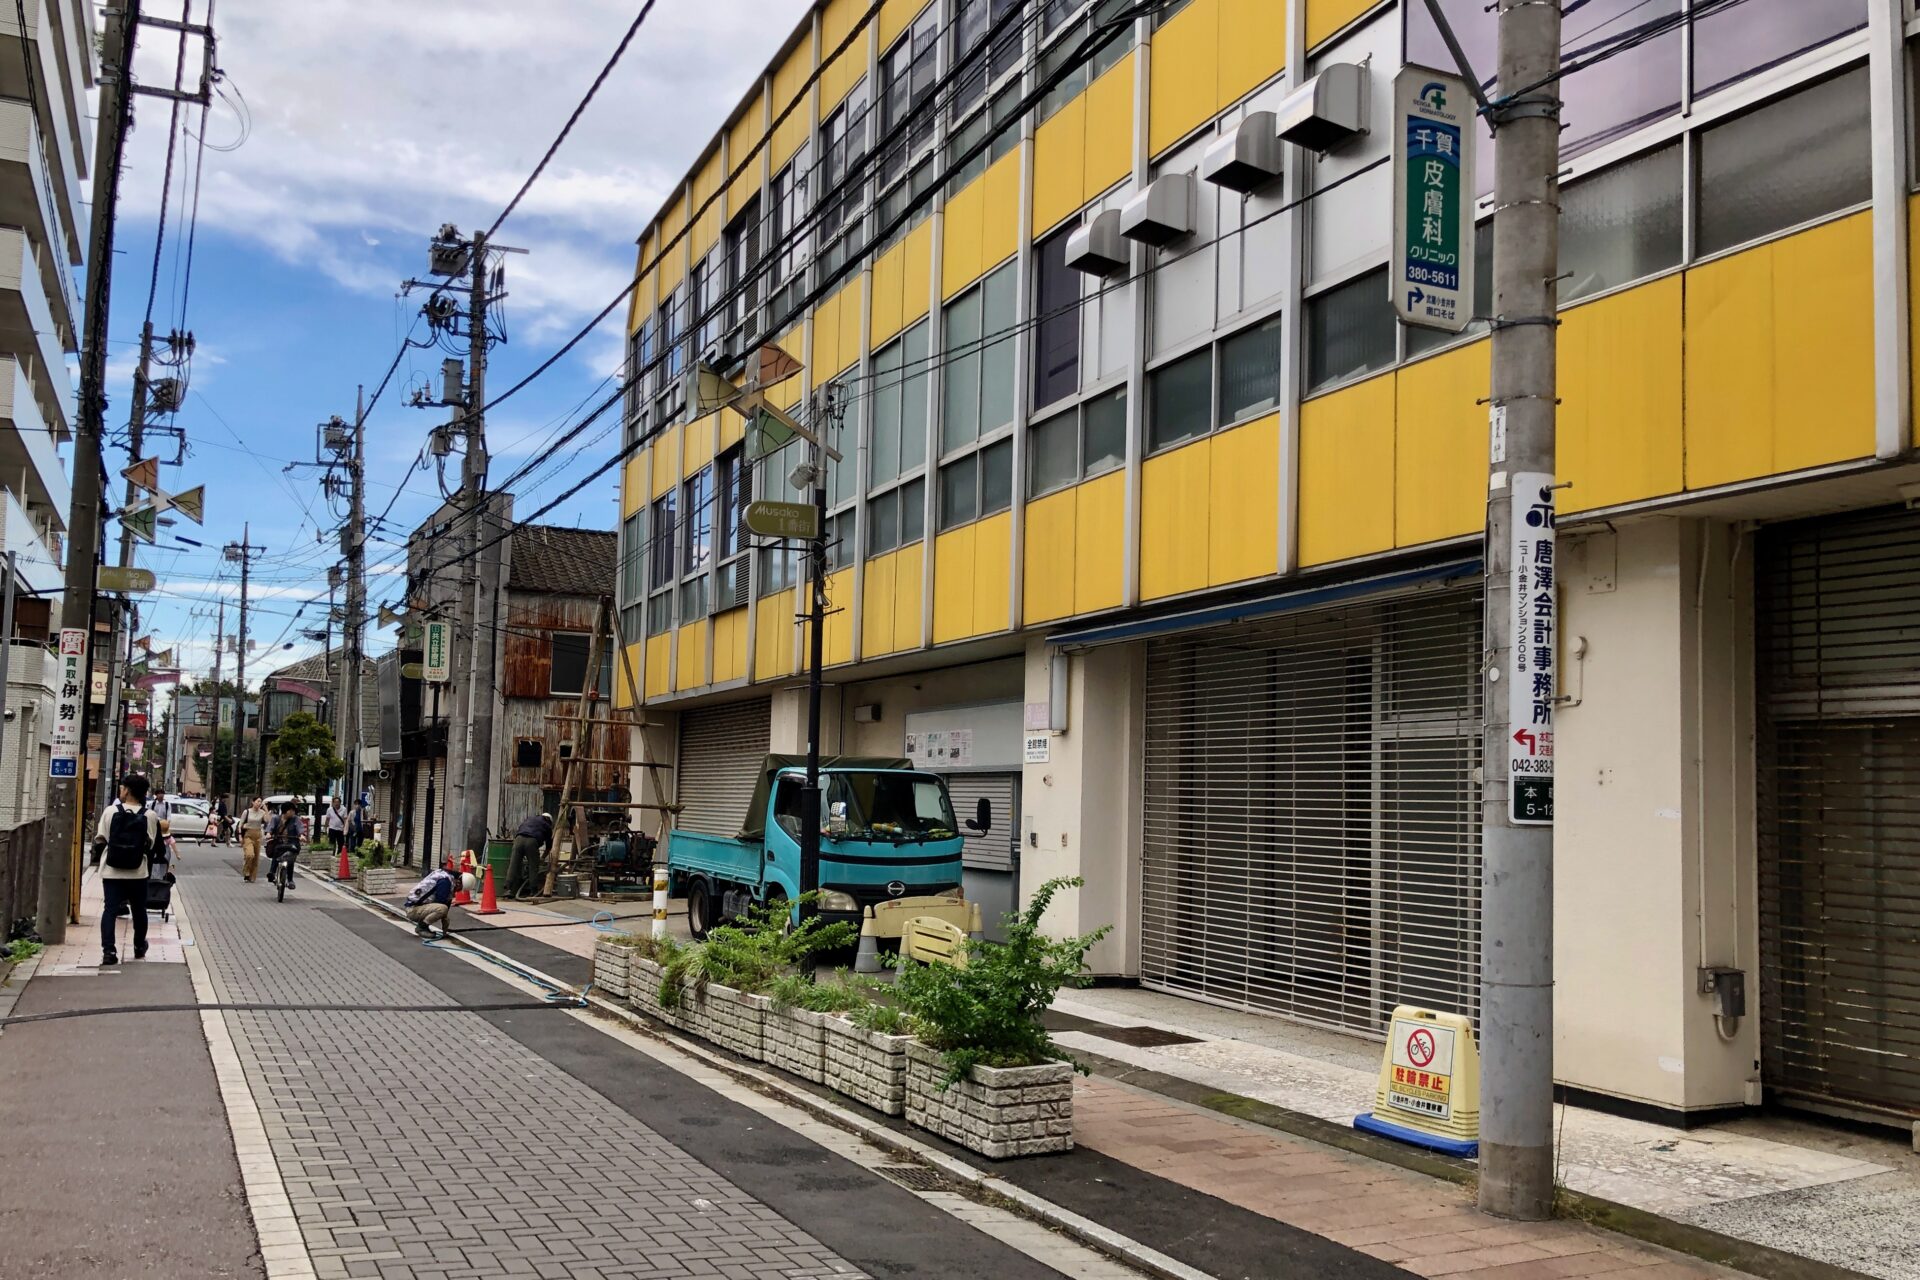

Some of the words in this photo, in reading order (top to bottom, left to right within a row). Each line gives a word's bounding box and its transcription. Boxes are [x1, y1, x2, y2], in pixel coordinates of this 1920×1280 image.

[1415, 129, 1453, 156] 千賀
[1422, 160, 1444, 246] 皮膚科
[1409, 246, 1456, 265] クリニック
[1408, 265, 1456, 287] 380-5611
[755, 504, 800, 518] Musako
[1518, 540, 1528, 673] ニュー小金井マンション206号
[1532, 539, 1553, 725] 唐澤会計事務所
[60, 683, 78, 720] 伊勢
[1395, 1067, 1443, 1091] 駐輪禁止
[1422, 1091, 1447, 1102] PARKING
